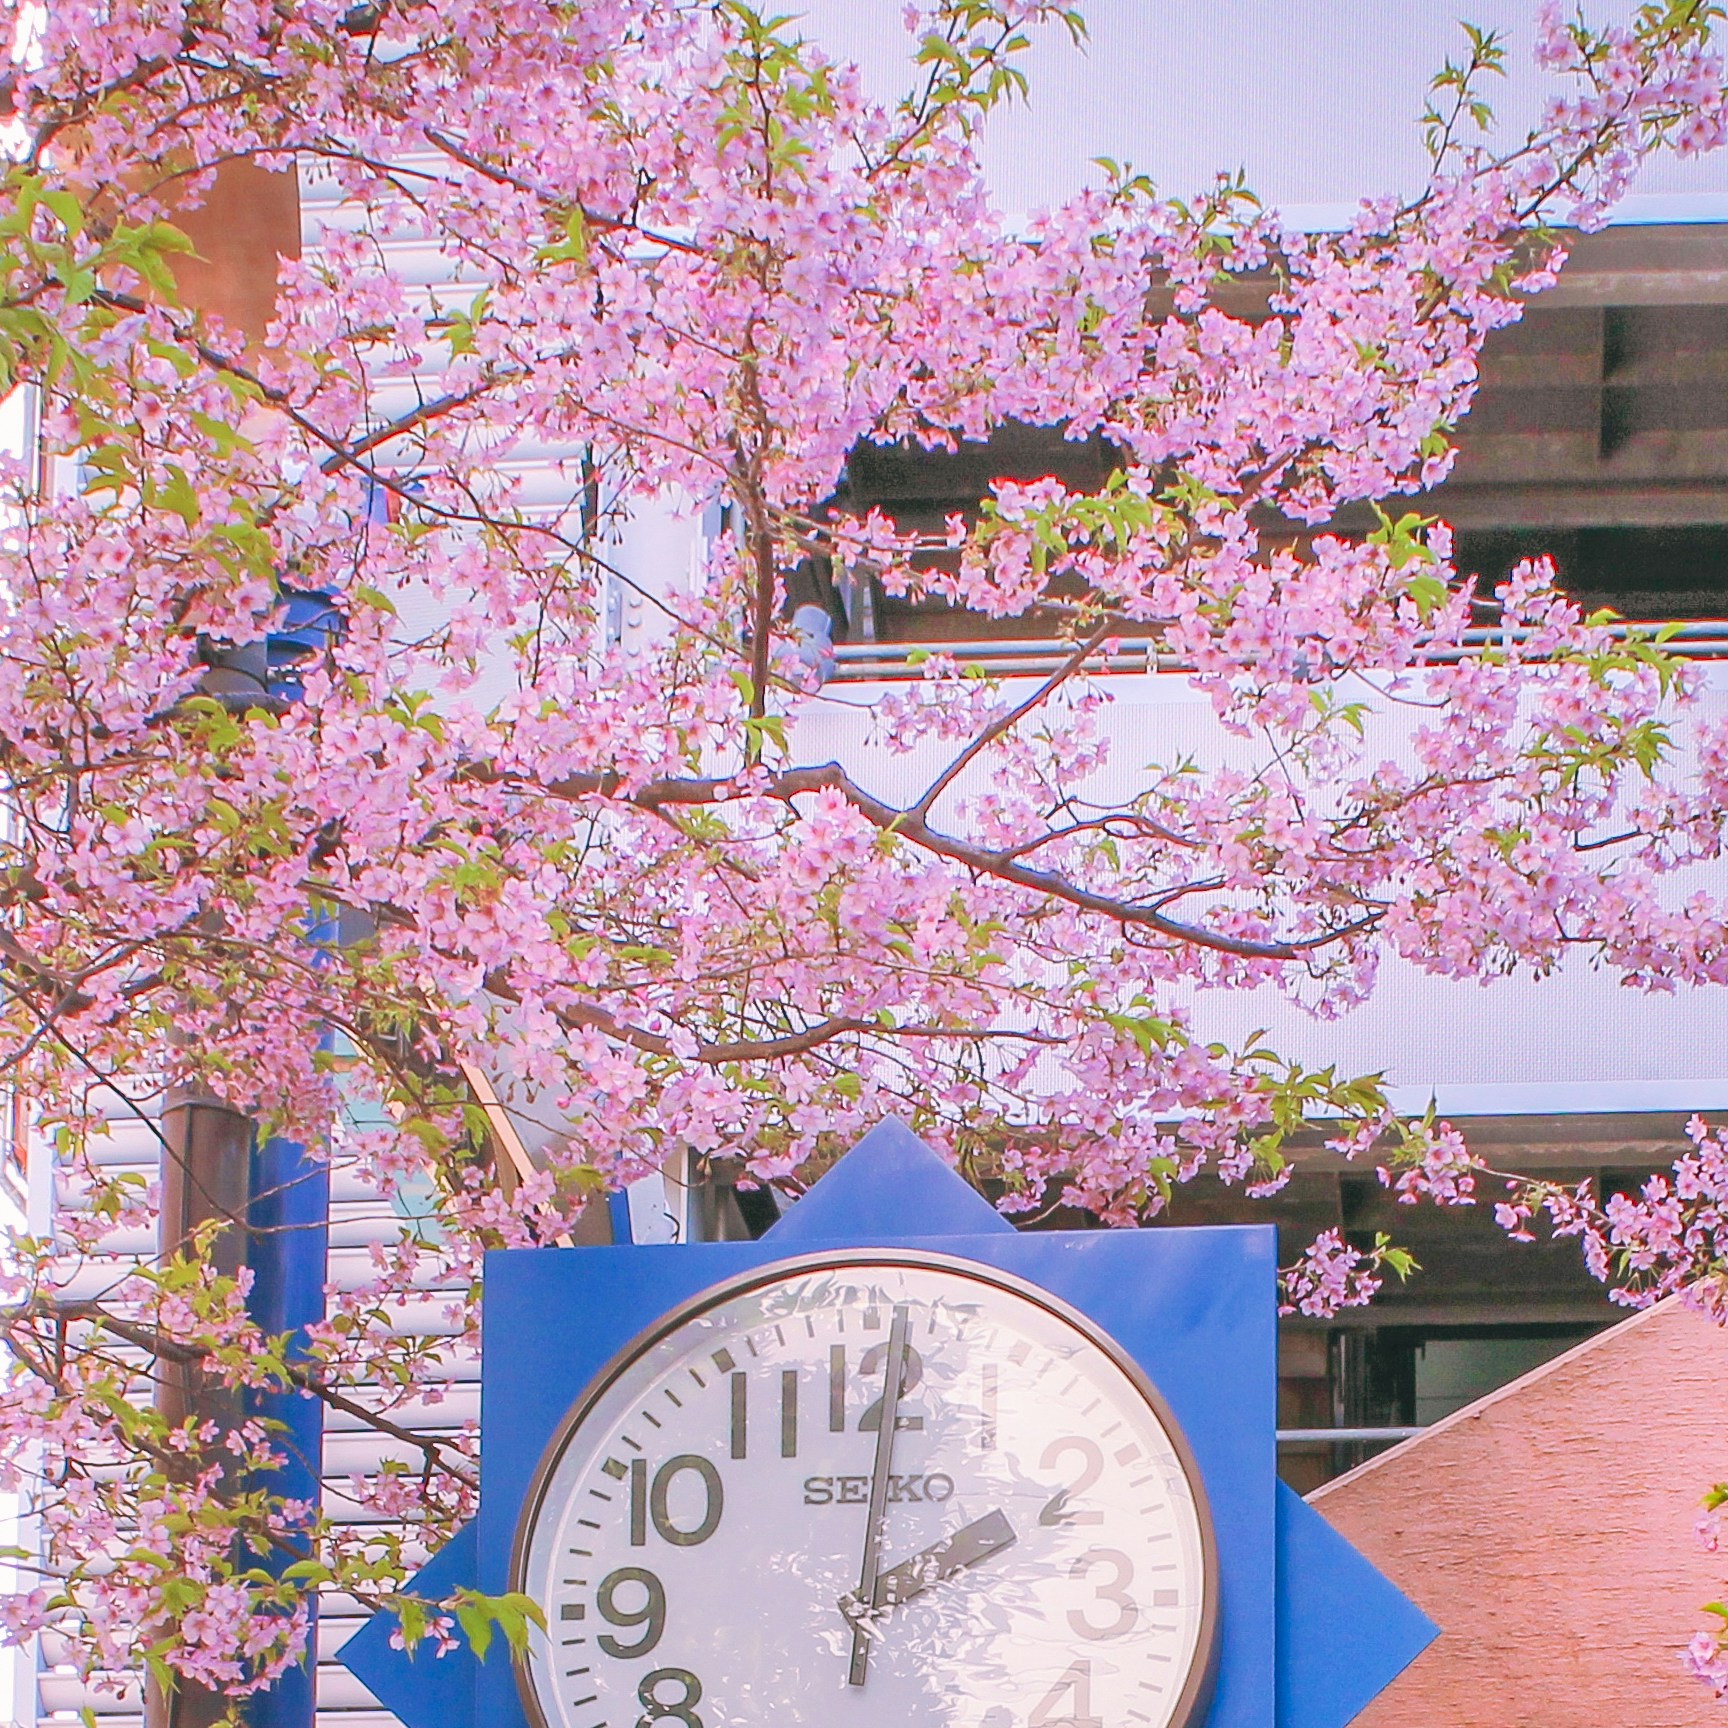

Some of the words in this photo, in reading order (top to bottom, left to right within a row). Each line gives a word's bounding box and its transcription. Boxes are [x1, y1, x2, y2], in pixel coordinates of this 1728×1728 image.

[730, 1370, 797, 1459] 11
[830, 1342, 924, 1433] 12
[982, 1363, 998, 1451] 1
[630, 1454, 724, 1545] 10
[803, 1473, 955, 1504] SEKO
[1038, 1436, 1104, 1526] 2
[596, 1568, 665, 1660] 9
[1065, 1548, 1138, 1641] 3
